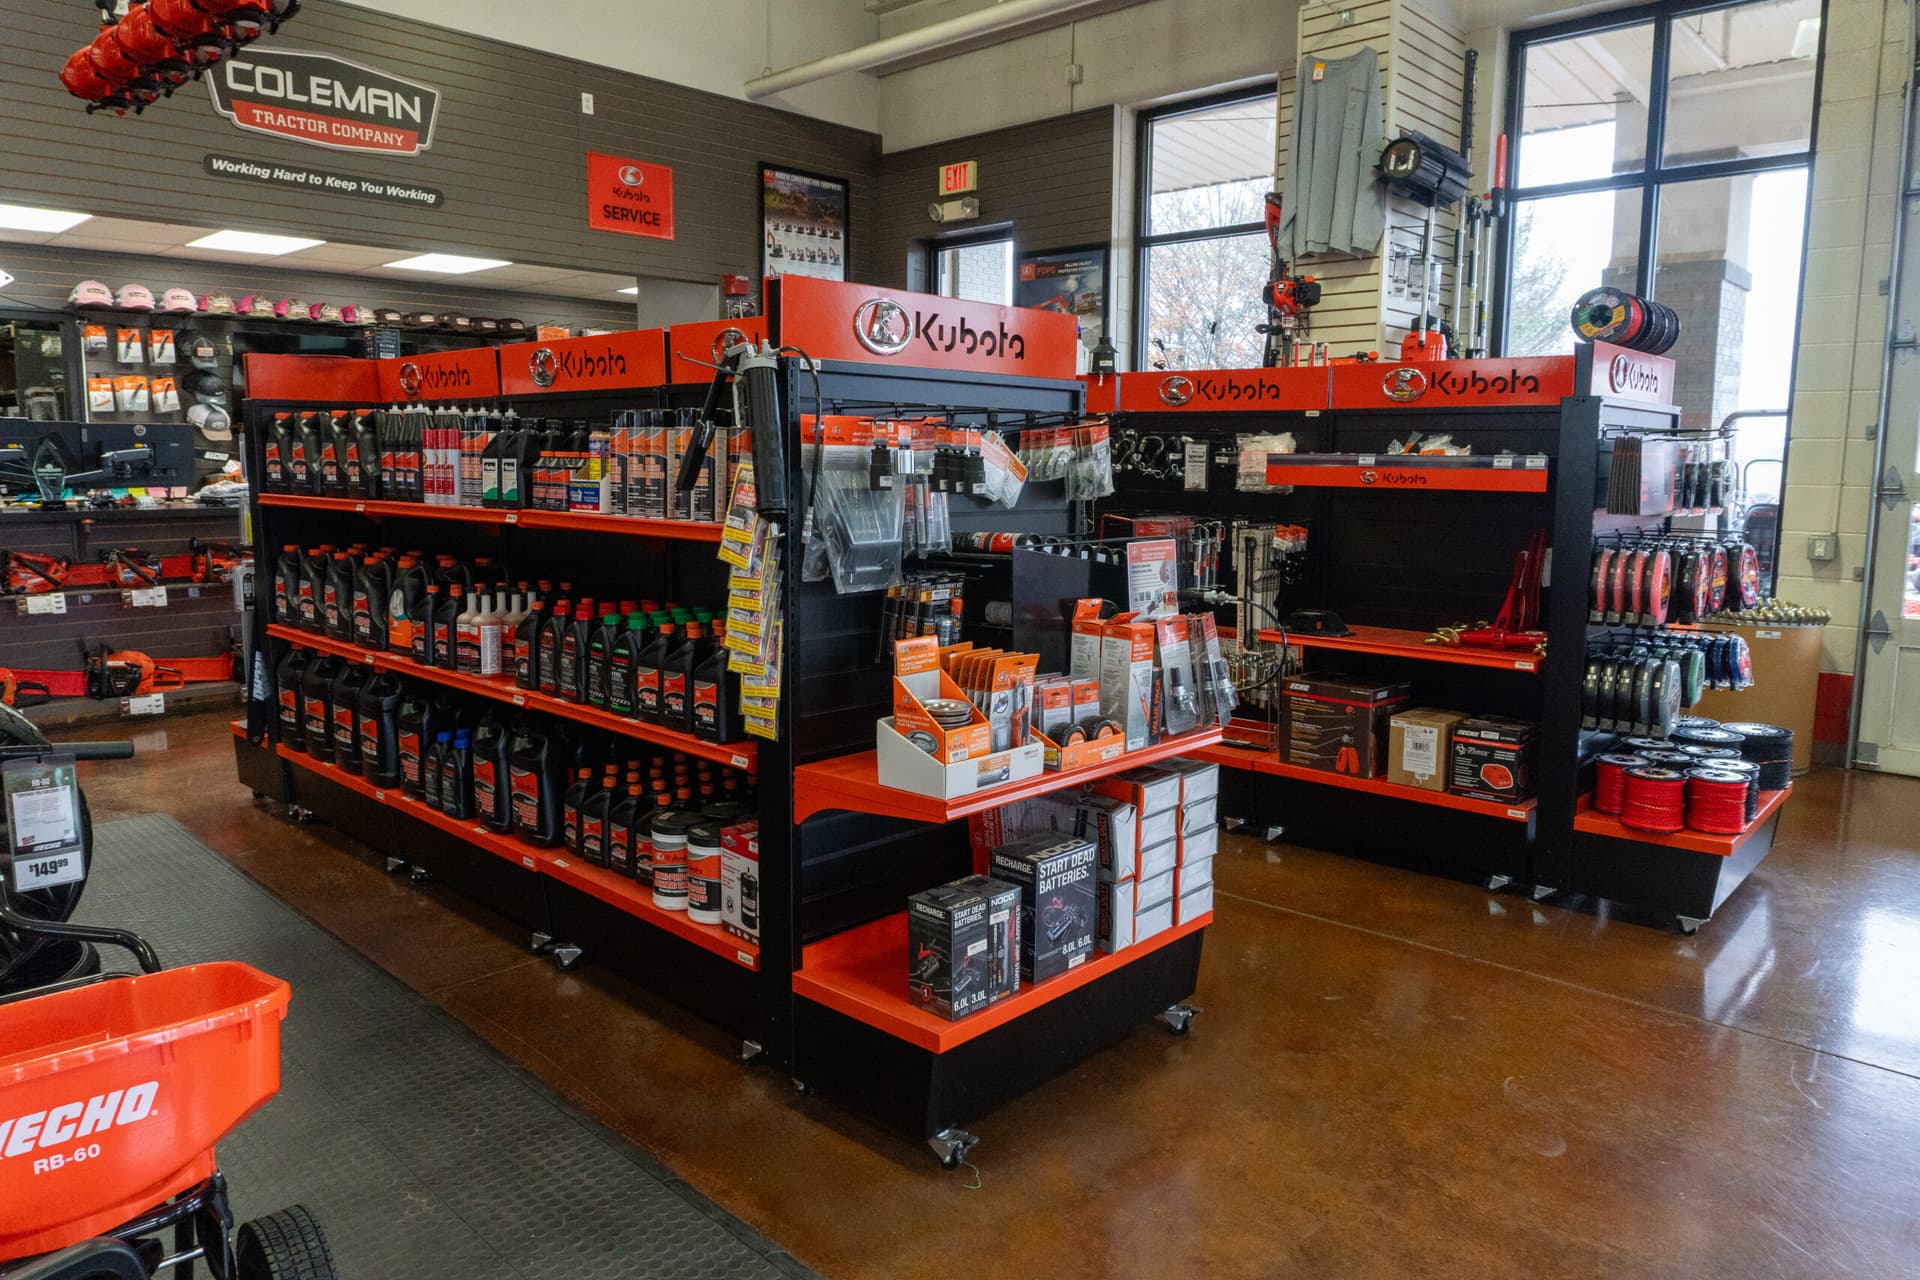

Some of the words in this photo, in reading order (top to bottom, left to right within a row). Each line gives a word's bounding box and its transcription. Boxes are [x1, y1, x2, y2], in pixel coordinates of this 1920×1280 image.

[225, 59, 421, 124] COLEMAN
[252, 109, 328, 135] TRACTOR
[332, 123, 404, 147] COMPANY
[212, 158, 271, 179] Working
[273, 168, 306, 183] Hard
[309, 174, 323, 185] to
[325, 176, 358, 191] Keep
[361, 181, 383, 194] You
[386, 186, 436, 203] Working
[945, 163, 968, 191] EXIT
[612, 186, 651, 203] Kubota
[603, 204, 661, 226] SERVICE
[915, 310, 1025, 360] Kubota
[560, 346, 627, 379] Kubota
[421, 364, 471, 388] Kubota
[1431, 371, 1539, 396] Kubota
[1628, 361, 1659, 393] Kubota
[1197, 378, 1280, 401] Kubota
[1382, 472, 1427, 485] Kubota
[1153, 679, 1161, 704] PACK
[1026, 839, 1088, 861] NOCO
[1039, 857, 1070, 878] START
[1071, 848, 1095, 867] DEAD
[1039, 866, 1090, 895] BATTERIES.
[954, 907, 970, 921] START
[971, 903, 986, 914] DEAD
[991, 893, 1015, 907] NOCO
[1062, 942, 1076, 955] 8.0L
[1078, 934, 1092, 948] 6.0L
[954, 999, 969, 1012] 6.0L
[971, 990, 987, 1004] 3.0L
[4, 1081, 159, 1157] ECHO
[33, 1143, 101, 1175] RB-60
